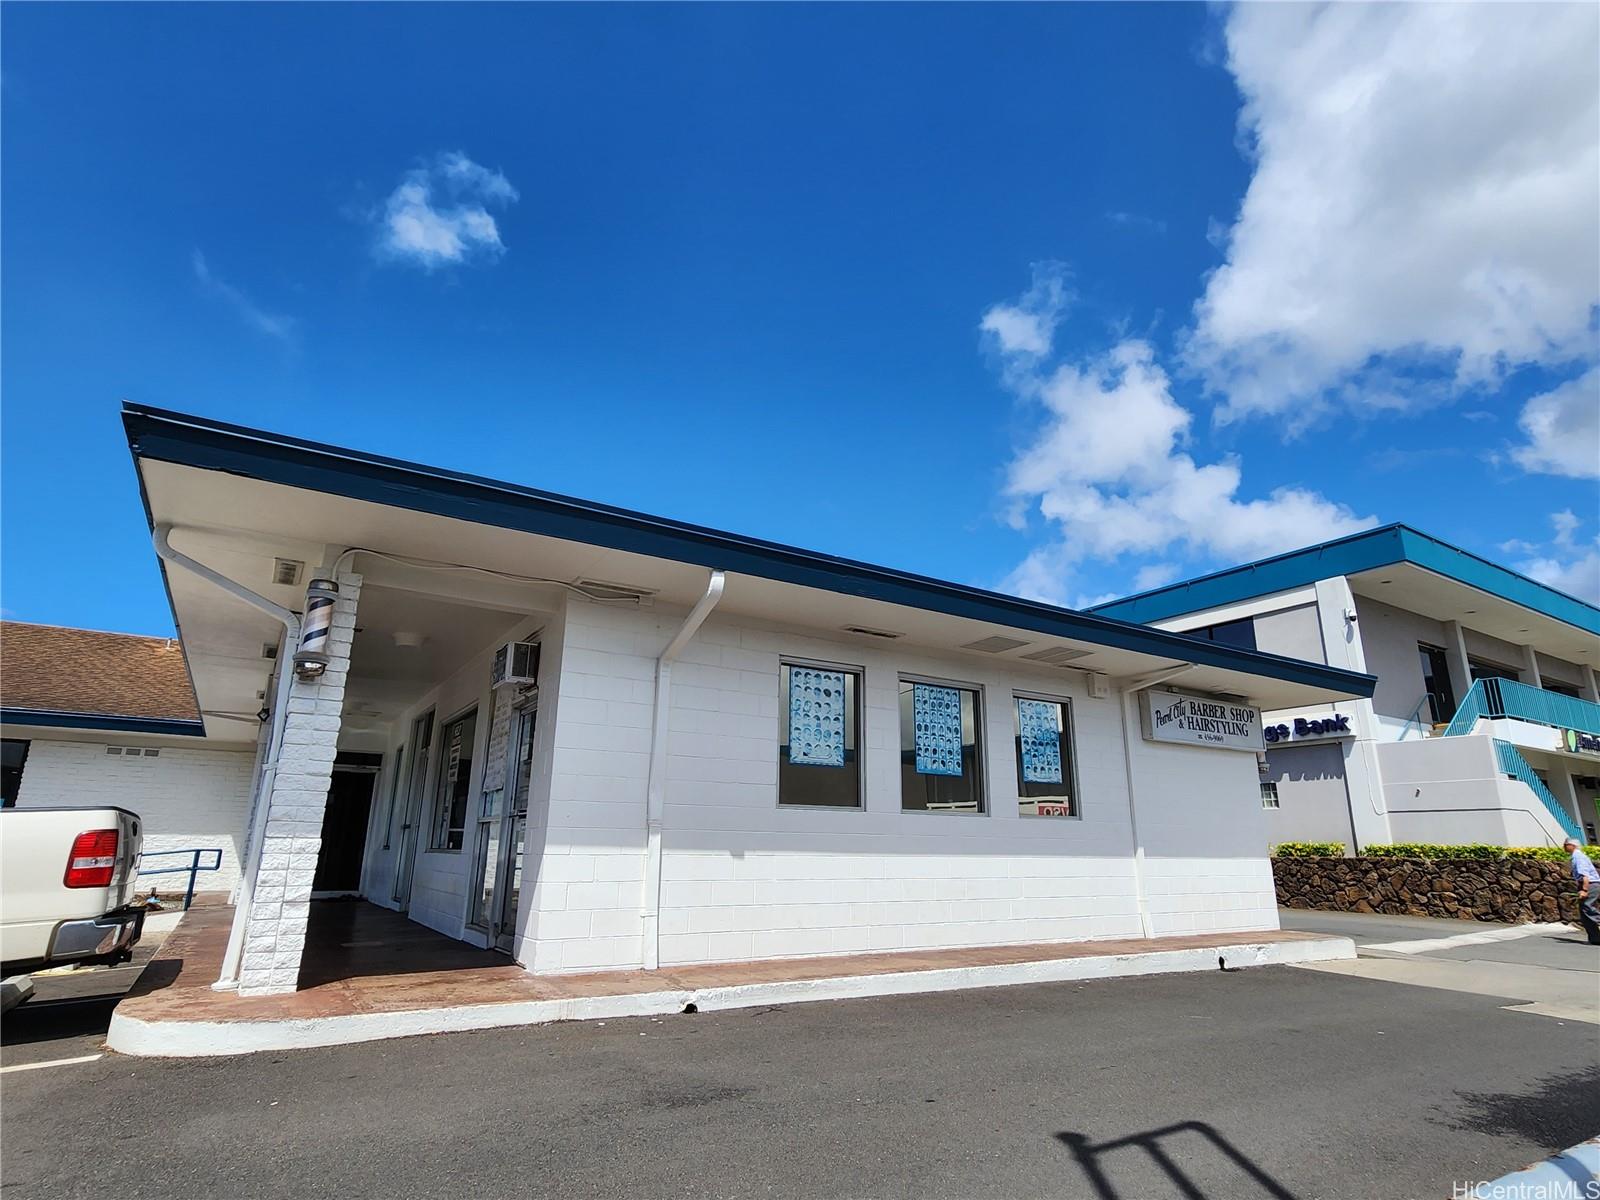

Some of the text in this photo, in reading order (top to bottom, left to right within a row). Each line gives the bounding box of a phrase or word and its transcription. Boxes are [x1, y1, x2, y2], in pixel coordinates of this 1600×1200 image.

[1168, 697, 1186, 721] City
[1190, 701, 1227, 719] BARBER
[1230, 707, 1254, 723] SHOP
[1178, 715, 1248, 736] & HAIRSTYLING
[1294, 714, 1350, 735] Bank
